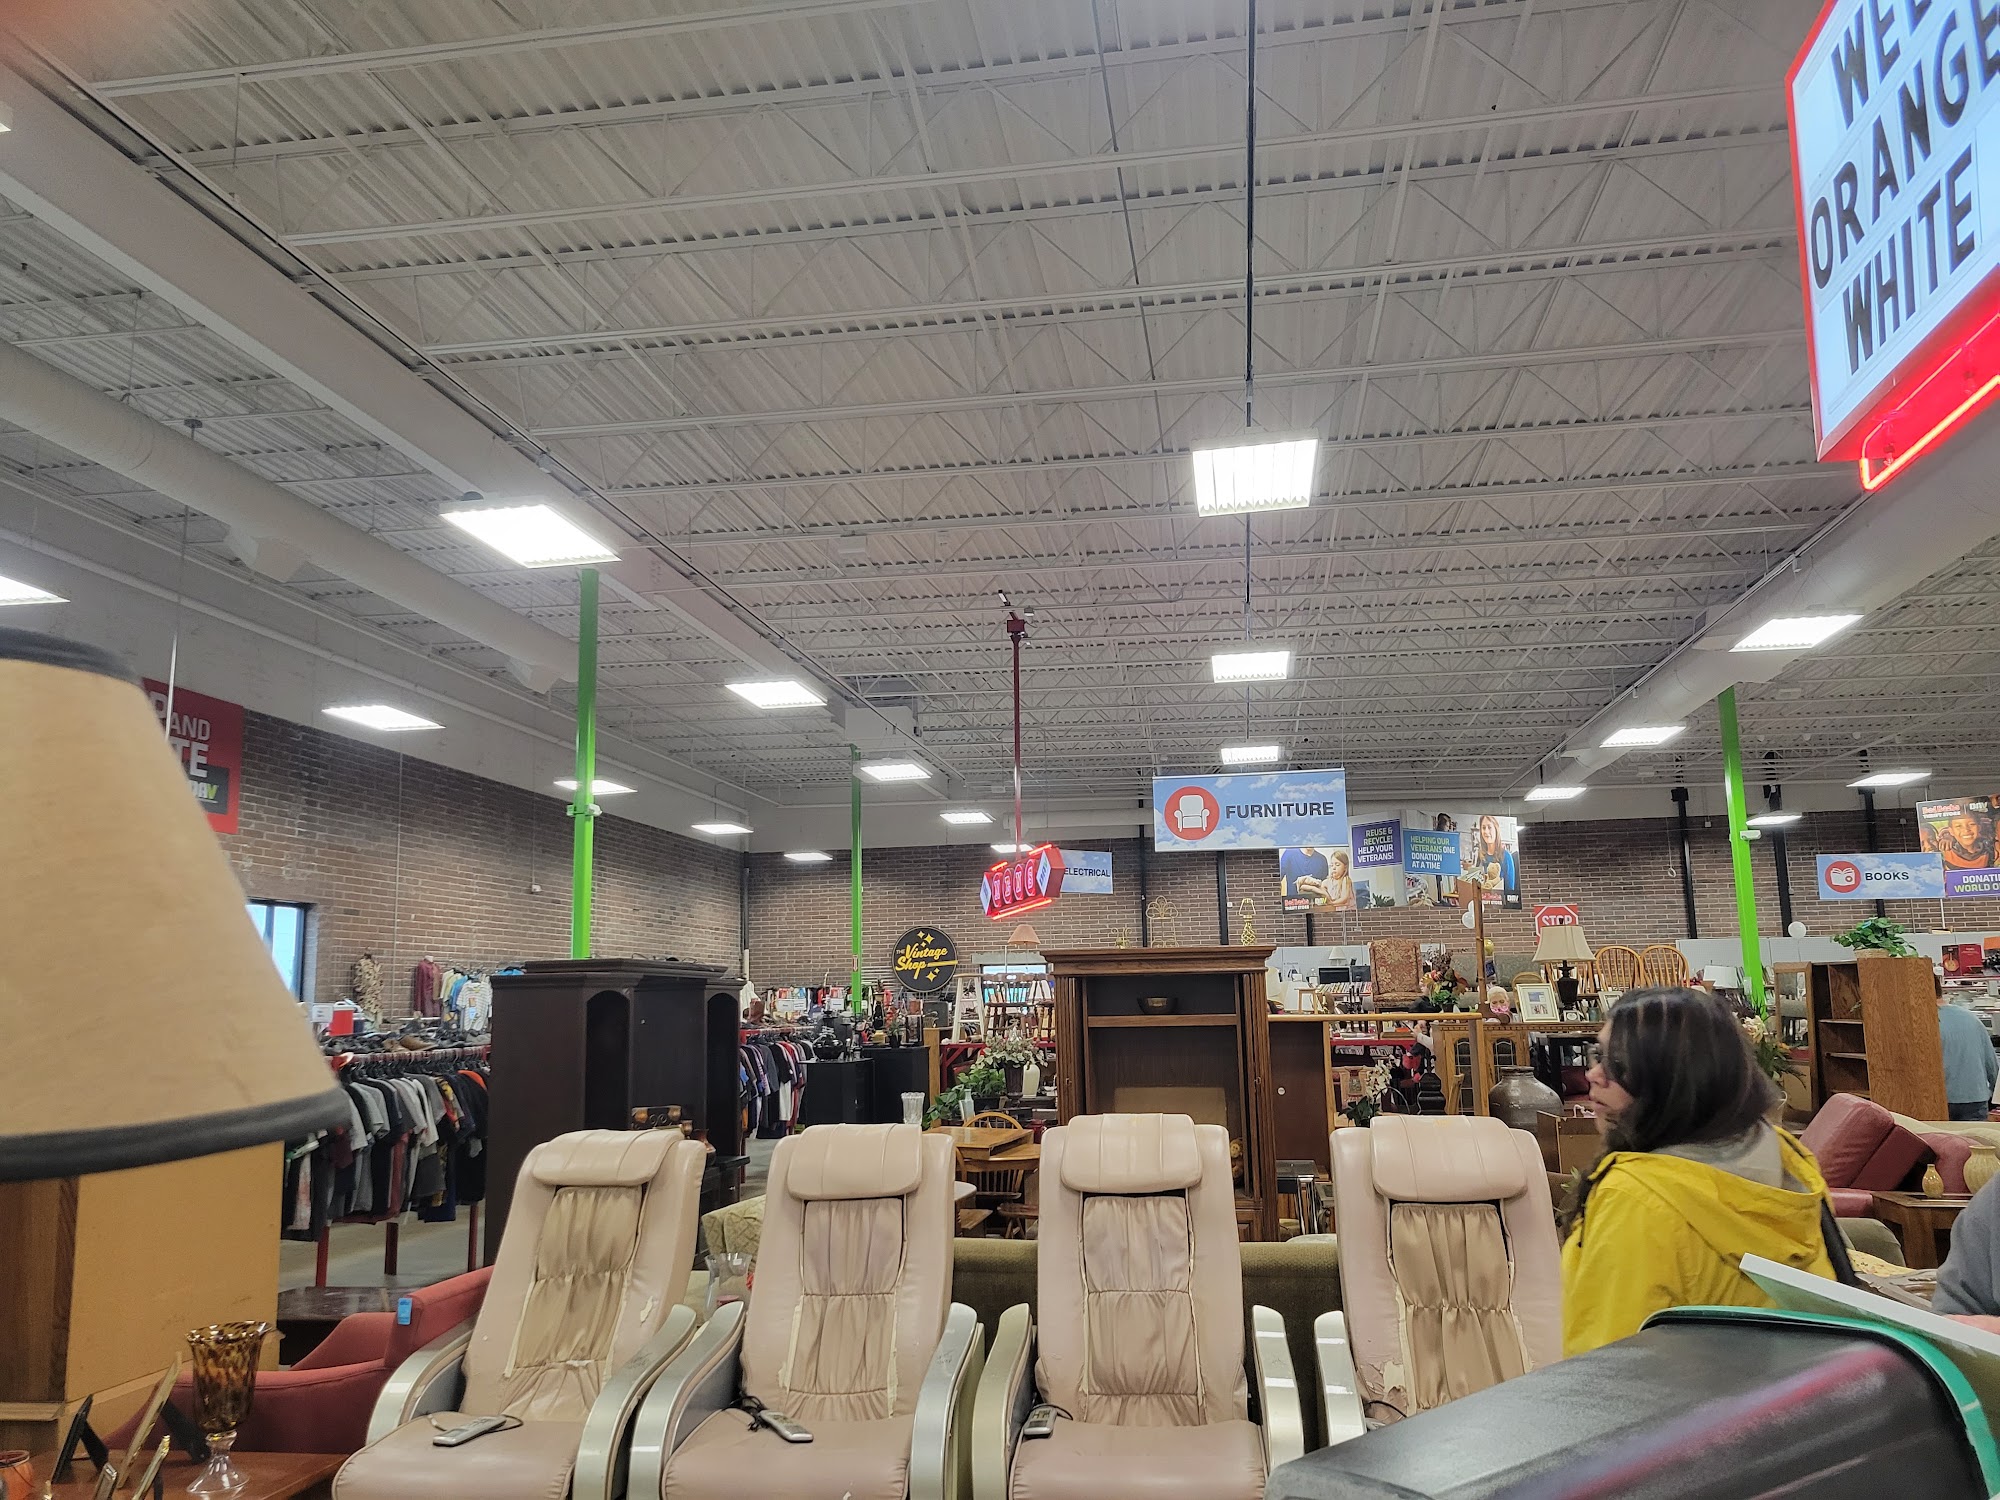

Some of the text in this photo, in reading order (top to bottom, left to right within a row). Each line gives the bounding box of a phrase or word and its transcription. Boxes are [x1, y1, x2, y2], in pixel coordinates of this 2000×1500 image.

[1842, 143, 1975, 376] WHITE
[170, 711, 211, 742] AND
[1225, 801, 1335, 819] FURNITURE
[1366, 826, 1393, 838] REUSE &
[1363, 835, 1393, 846] RECYCLE!
[1410, 835, 1450, 845] HELPING OUR
[1358, 843, 1394, 855] HELP YOUR
[1410, 844, 1456, 854] VETERANS ONE
[1357, 852, 1394, 863] VETERANS!
[1411, 852, 1443, 862] DONATION
[1425, 861, 1441, 870] TIME
[1064, 867, 1111, 878] ELECTRICAL
[1865, 871, 1910, 881] BOOKS
[1962, 873, 2000, 884] DONATI
[1954, 883, 1990, 893] WORLD
[1541, 914, 1573, 926] STOP
[904, 943, 948, 960] Vintage
[895, 956, 927, 980] Shop
